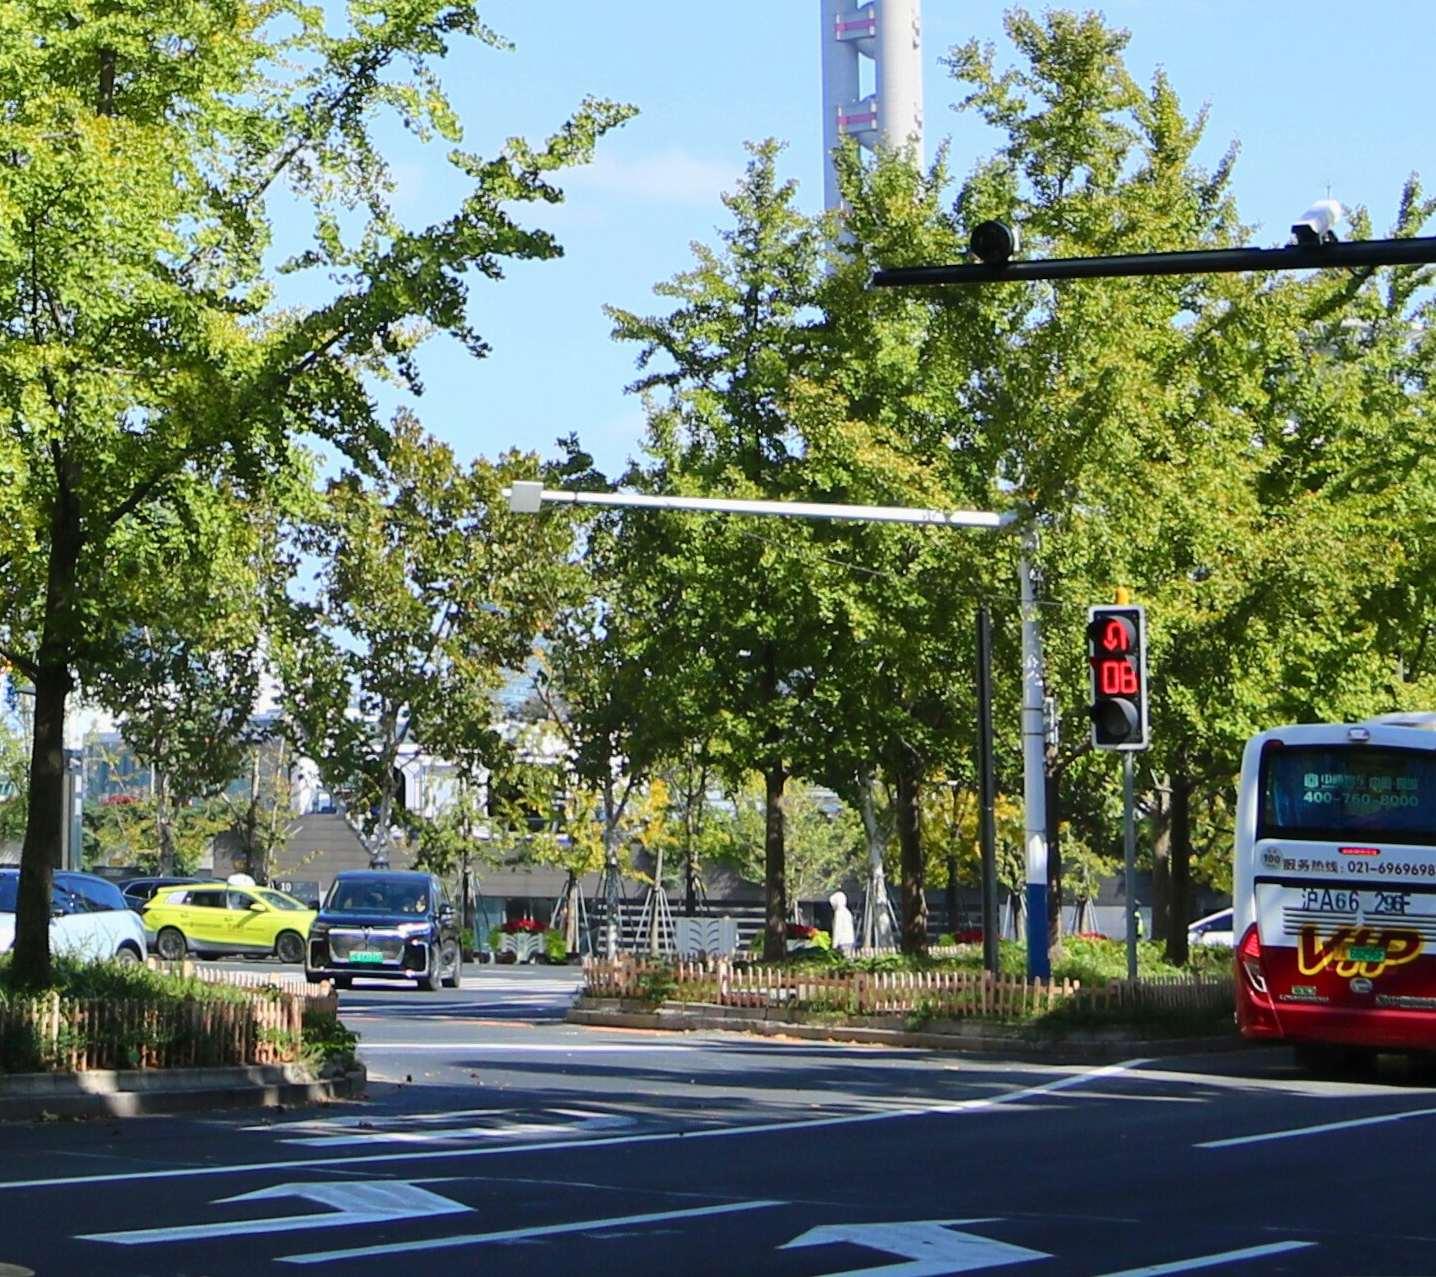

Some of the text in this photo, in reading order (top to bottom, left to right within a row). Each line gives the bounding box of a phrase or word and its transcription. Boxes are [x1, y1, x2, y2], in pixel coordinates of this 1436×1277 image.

[1102, 660, 1138, 695] 06
[1304, 791, 1420, 807] 400-760-8000
[1263, 853, 1281, 865] 100
